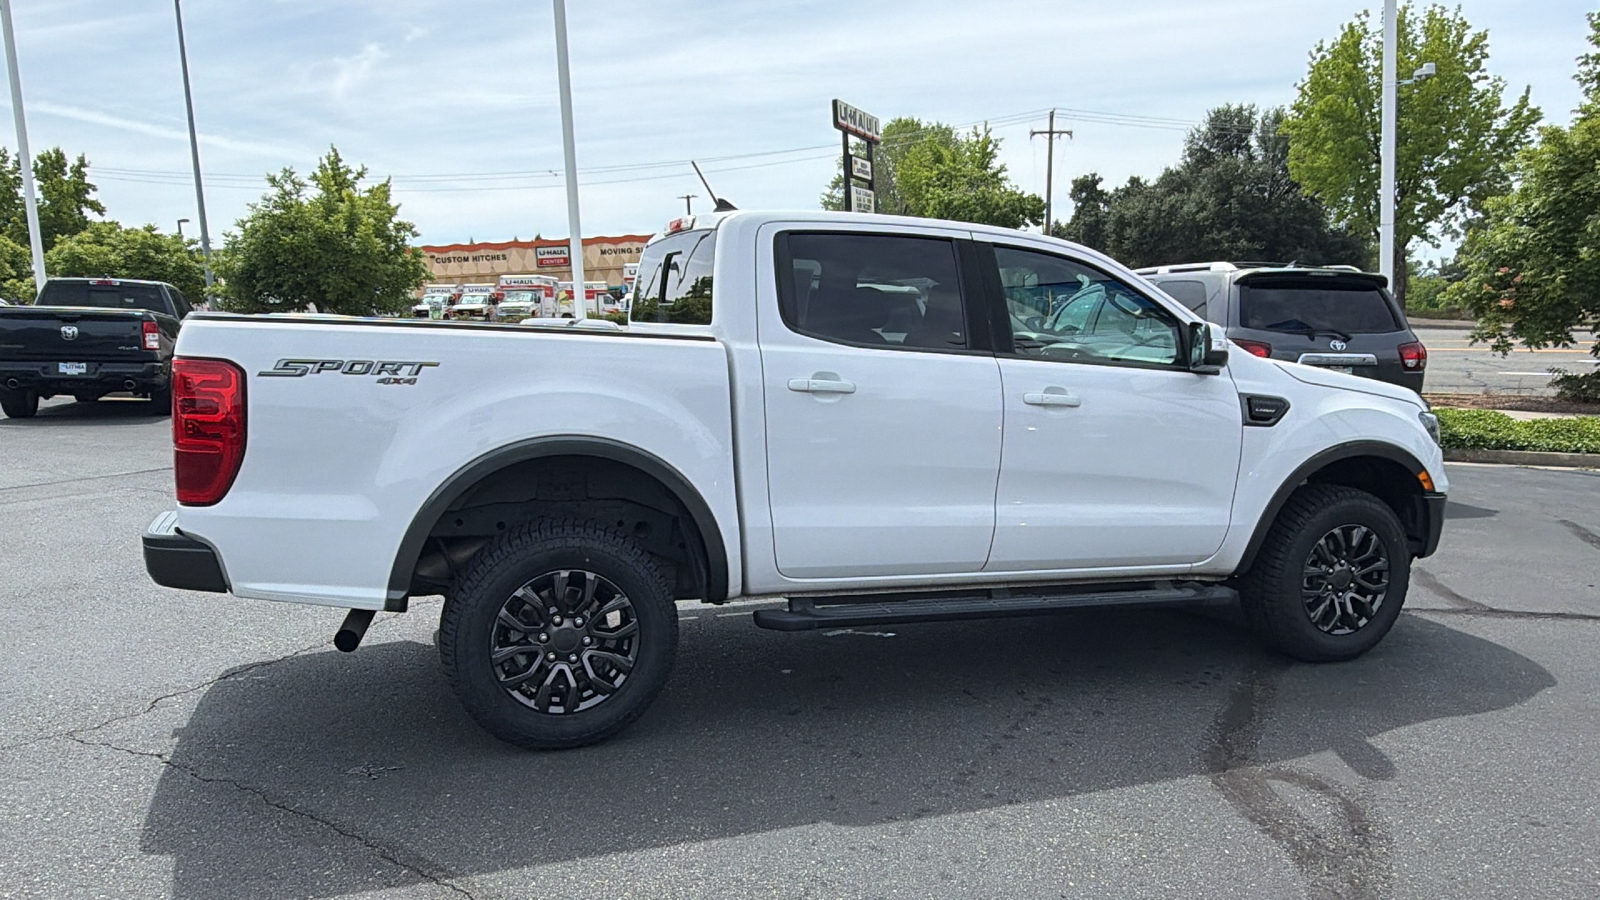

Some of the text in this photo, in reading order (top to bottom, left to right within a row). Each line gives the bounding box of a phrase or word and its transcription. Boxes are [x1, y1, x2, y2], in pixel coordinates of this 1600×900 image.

[600, 247, 633, 256] MOVING
[435, 253, 507, 264] CUSTOM HITCHES
[256, 358, 440, 377] SPORT
